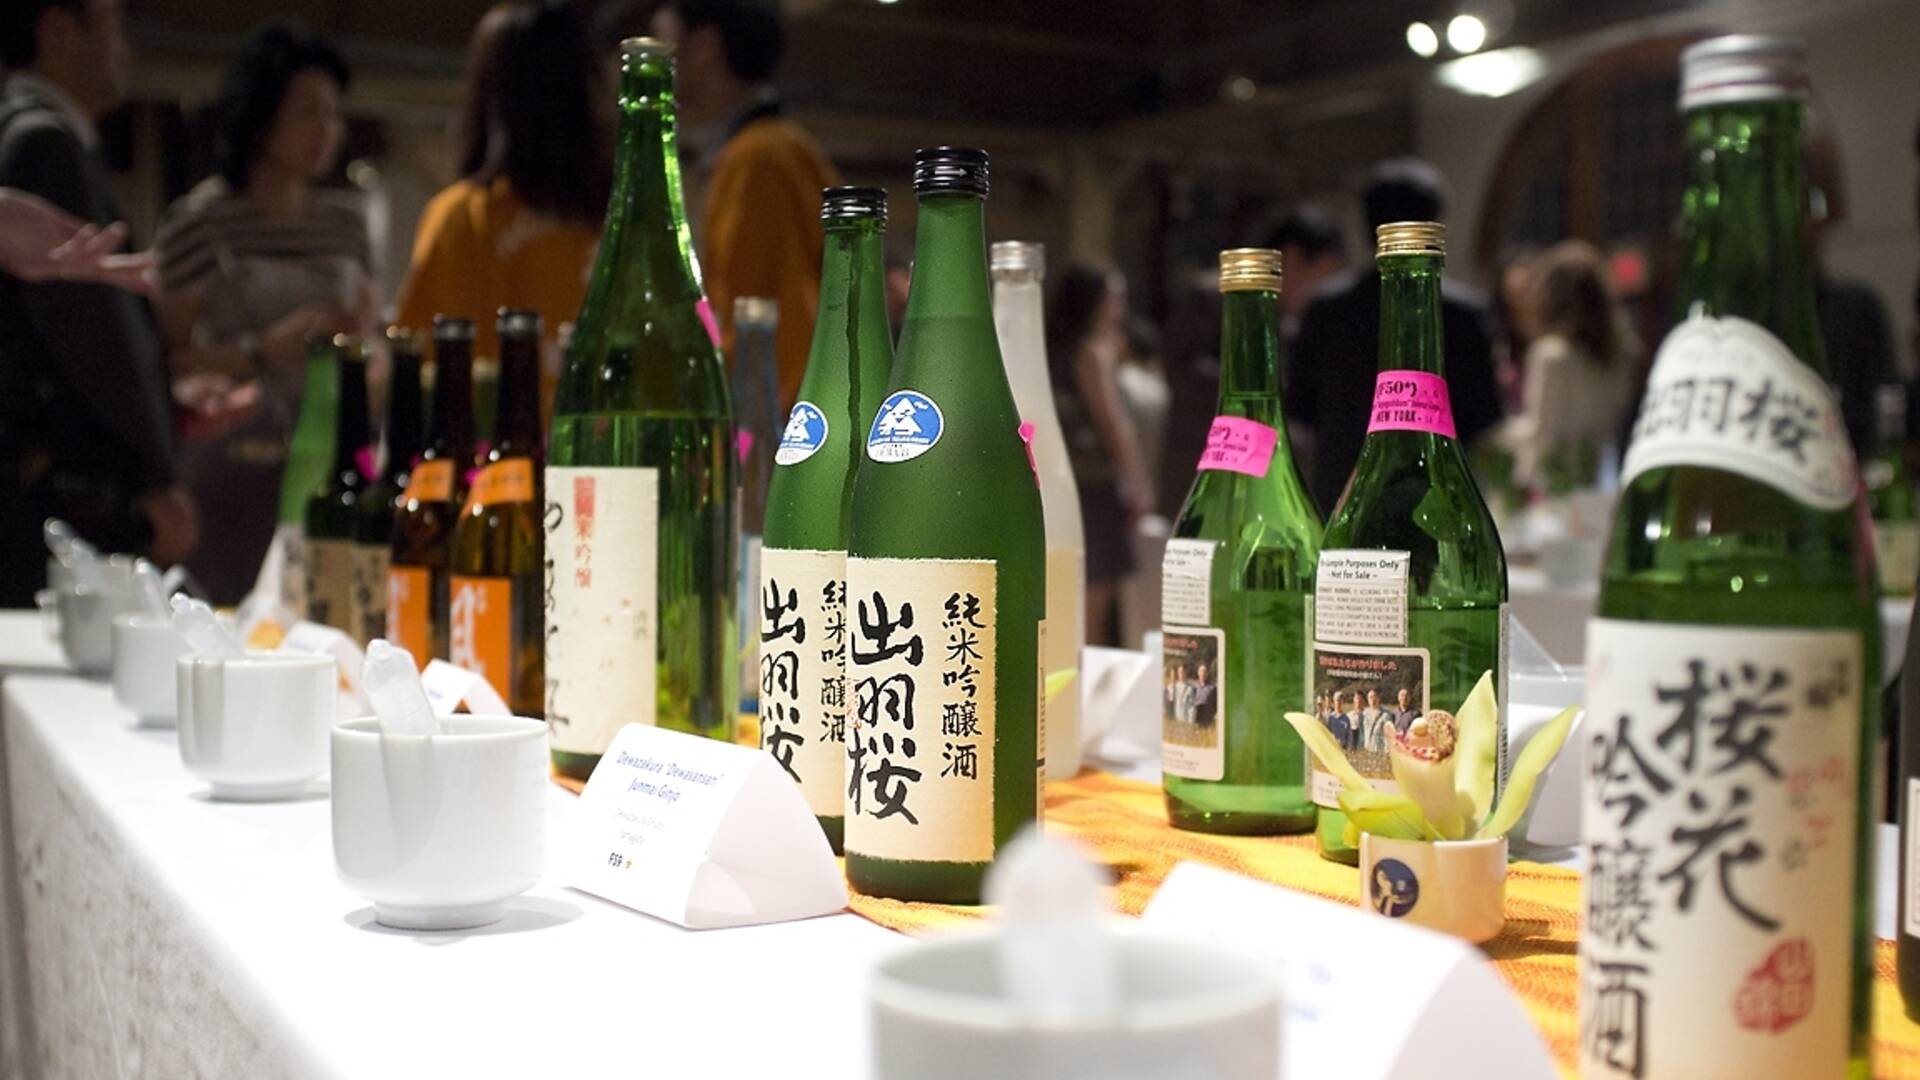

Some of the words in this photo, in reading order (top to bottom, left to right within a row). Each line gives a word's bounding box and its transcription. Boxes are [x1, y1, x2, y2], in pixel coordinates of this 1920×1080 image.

[1343, 570, 1353, 579] for
[1355, 570, 1371, 580] Sale
[1345, 559, 1377, 569] Purposes
[1379, 560, 1400, 571] Only
[848, 590, 924, 825] 出羽桜
[616, 750, 664, 774] Dewazakura
[627, 777, 657, 796] Junmai
[1655, 658, 1789, 934] 桜花
